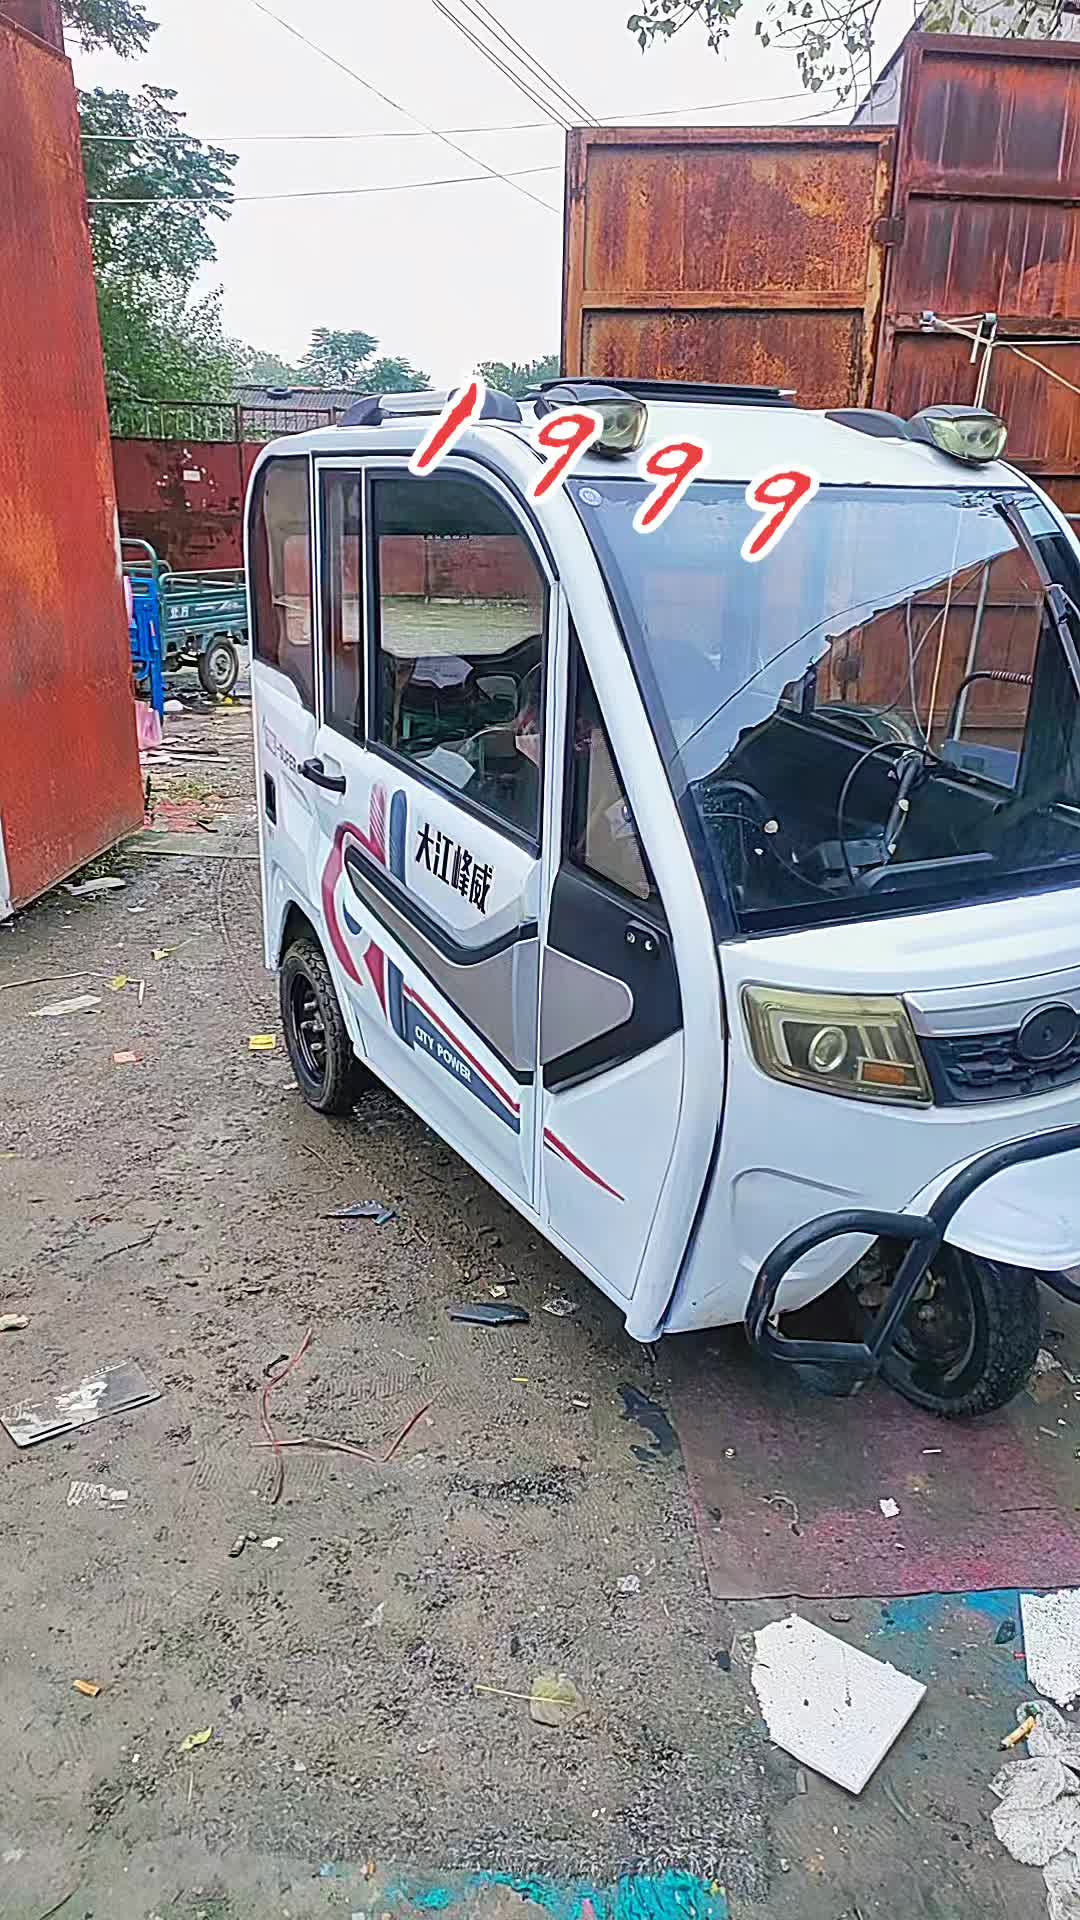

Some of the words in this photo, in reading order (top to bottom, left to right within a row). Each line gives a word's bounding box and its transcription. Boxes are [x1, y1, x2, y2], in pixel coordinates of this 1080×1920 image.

[415, 822, 494, 915] 大江峰威
[415, 1025, 434, 1050] CITY
[437, 1043, 472, 1083] POWER
